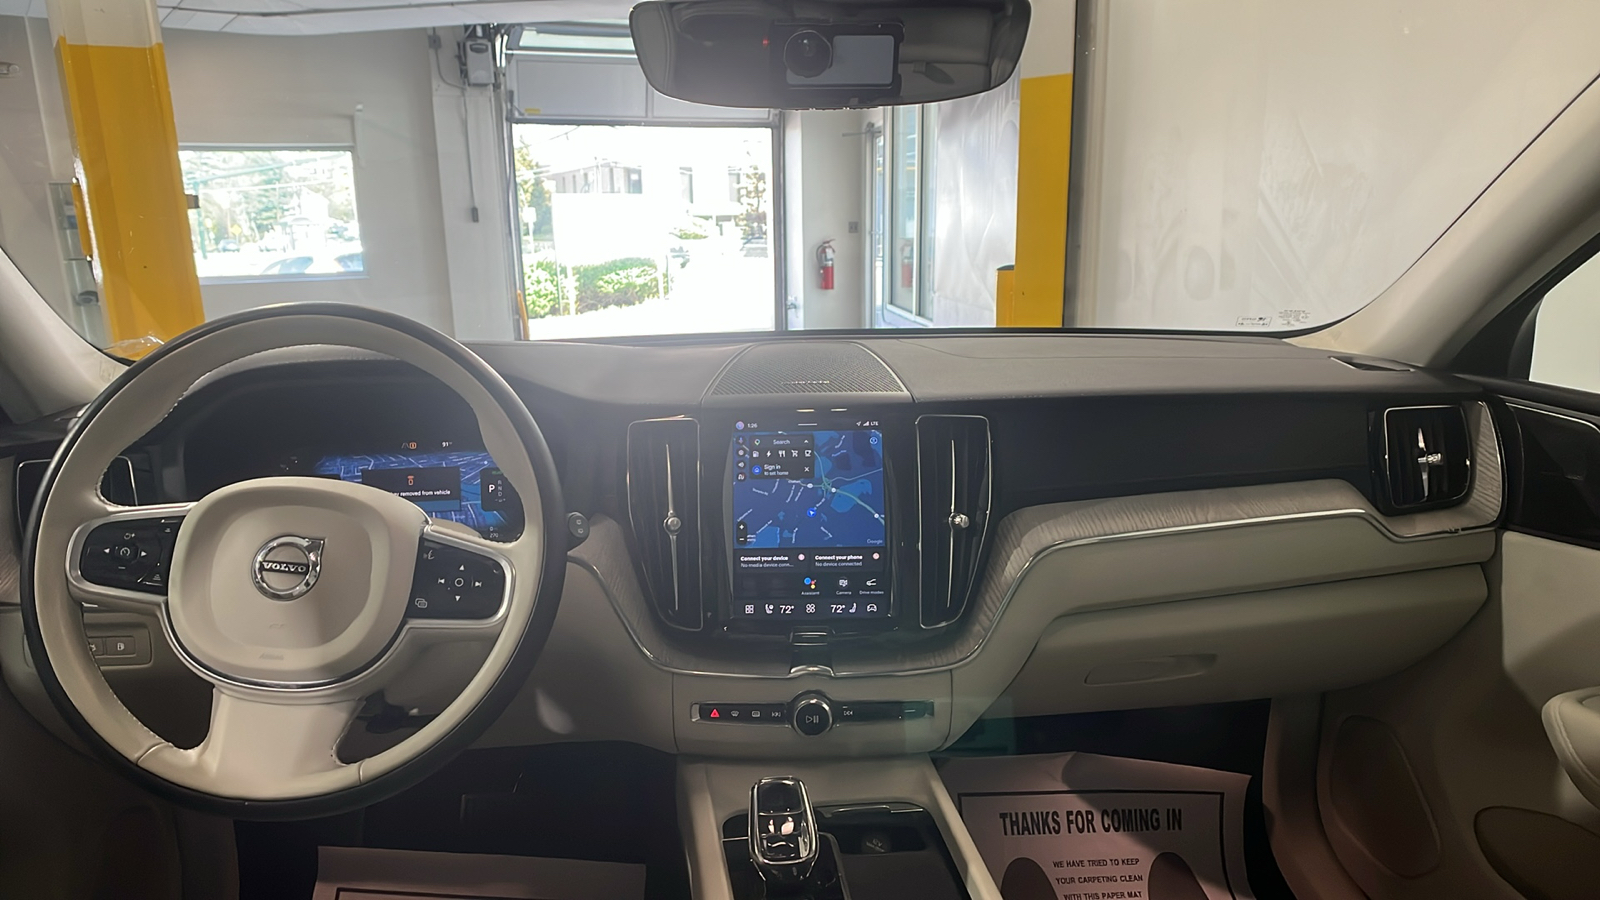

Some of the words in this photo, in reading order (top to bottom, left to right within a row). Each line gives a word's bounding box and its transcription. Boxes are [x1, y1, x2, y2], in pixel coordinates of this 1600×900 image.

[488, 484, 495, 493] P
[262, 561, 306, 573] VOLVO
[1000, 811, 1061, 836] THANKS
[1066, 810, 1096, 835] FOR
[1101, 808, 1160, 833] COMING
[1167, 808, 1183, 831] IN
[1087, 859, 1108, 867] TRIED
[1121, 858, 1139, 866] KEEP
[1055, 877, 1075, 885] YOUR
[1078, 875, 1118, 884] CARPETING
[1120, 874, 1143, 882] CLEAN
[1085, 892, 1100, 900] THIS
[1102, 891, 1125, 899] PAPER
[1127, 890, 1142, 898] MAT
